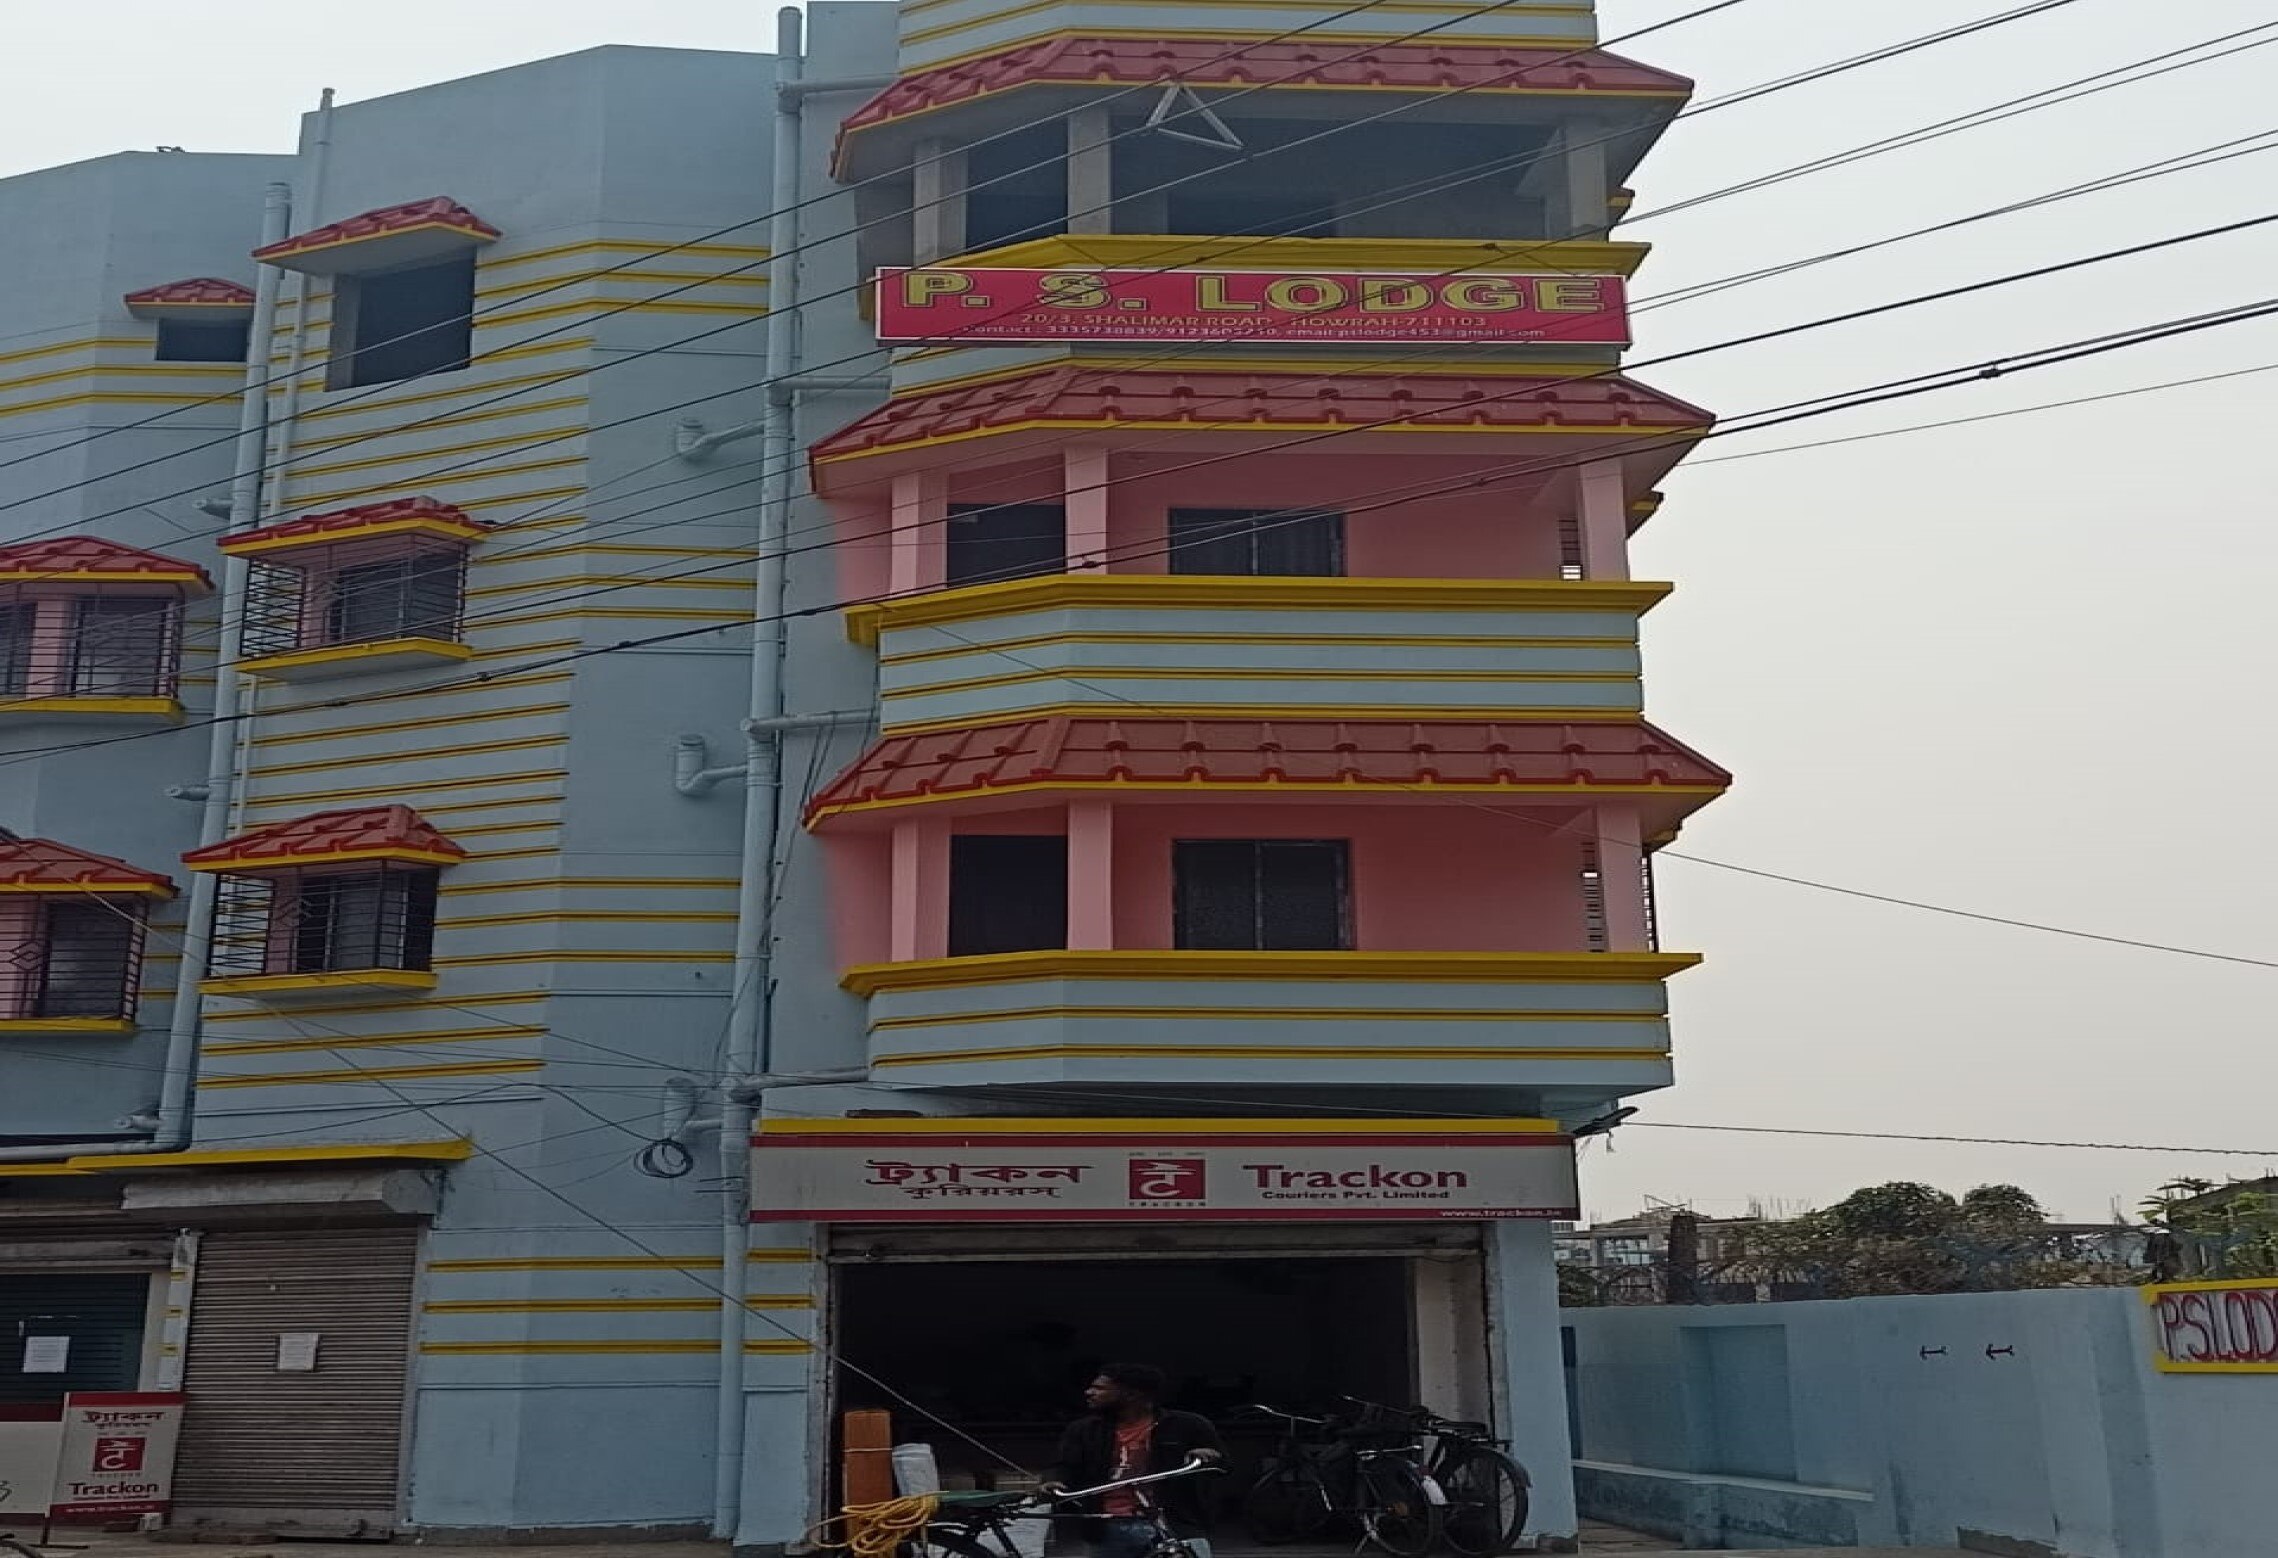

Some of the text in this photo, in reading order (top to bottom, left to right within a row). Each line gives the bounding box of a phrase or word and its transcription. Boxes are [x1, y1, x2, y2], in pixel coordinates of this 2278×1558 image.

[904, 272, 1604, 313] P. S. LODGE
[1084, 314, 1199, 326] SHALIMAR
[1243, 1165, 1467, 1188] Trackon
[1262, 1190, 1338, 1199] Couriers
[1383, 1190, 1450, 1199] Limited
[68, 1481, 160, 1495] Trackon
